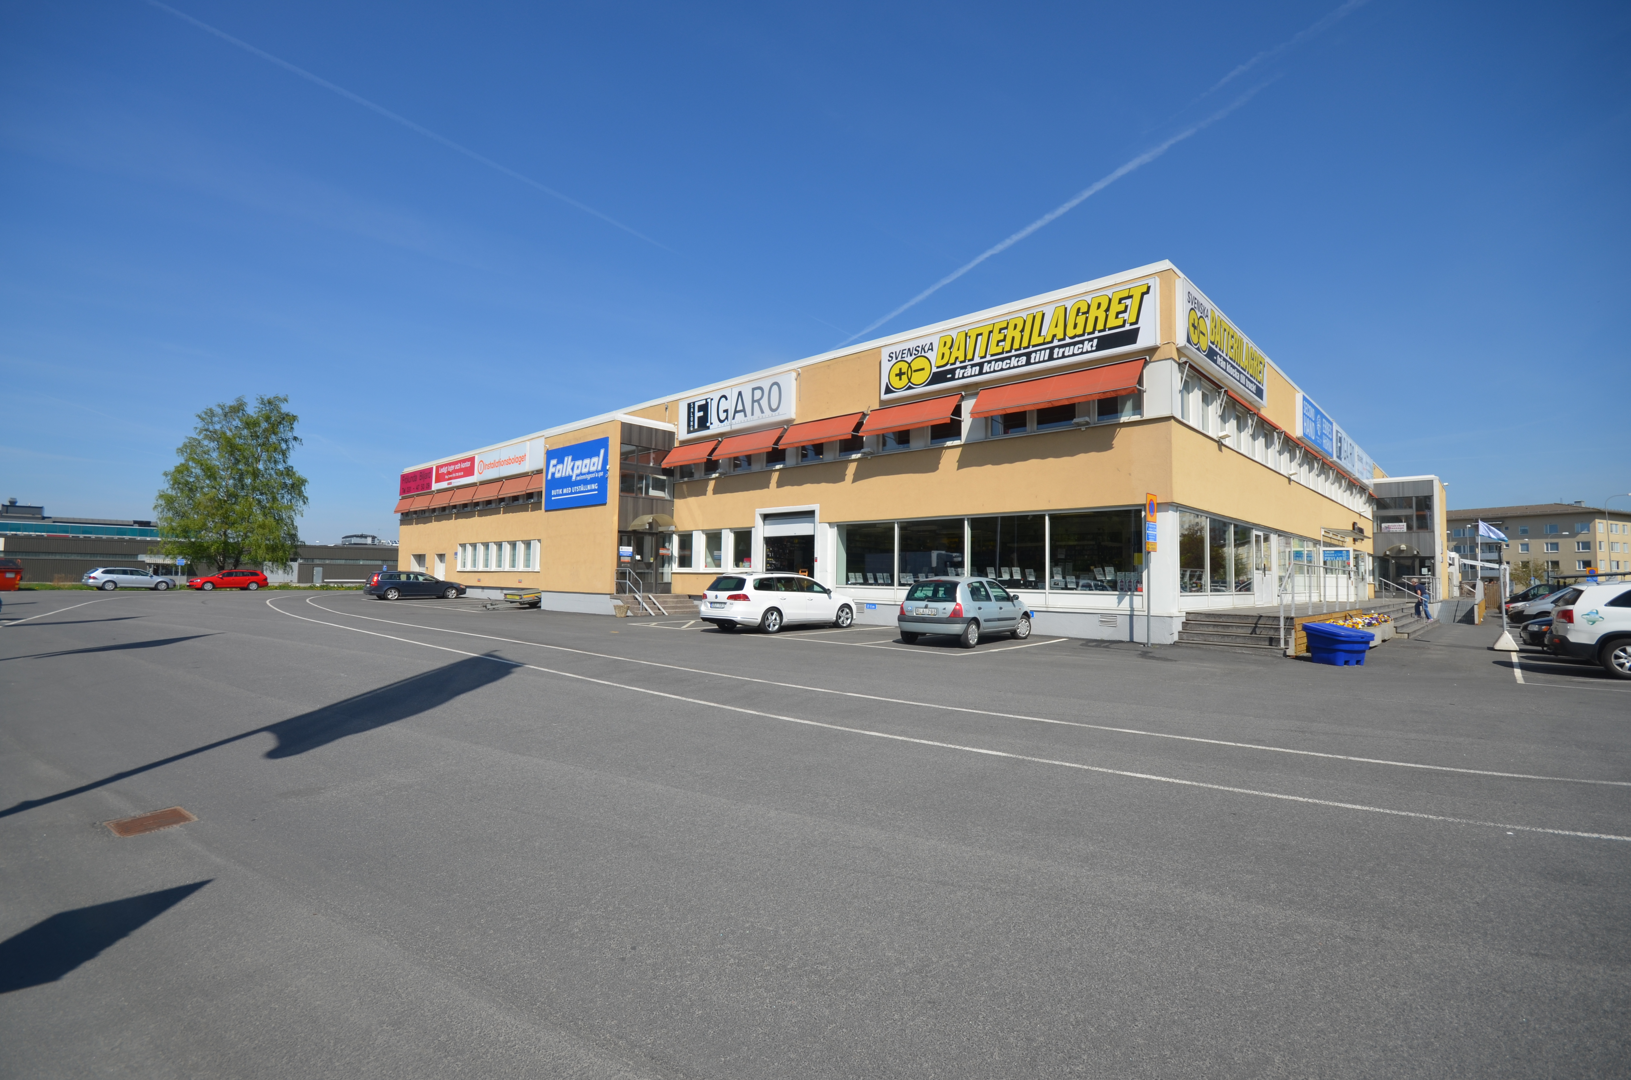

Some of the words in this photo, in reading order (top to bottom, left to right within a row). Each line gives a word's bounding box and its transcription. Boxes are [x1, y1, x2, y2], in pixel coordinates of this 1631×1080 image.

[1187, 291, 1209, 320] SVENSKA
[935, 283, 1151, 368] BATTERILAGRET
[887, 342, 934, 362] SVENSKA
[955, 365, 980, 379] från
[983, 350, 1026, 373] klocka
[1030, 347, 1049, 364] till
[1053, 339, 1097, 359] truck!
[1209, 308, 1265, 387] BATTERILAGRET
[695, 381, 782, 429] FIGARO
[547, 448, 605, 481] Folkpool
[552, 488, 562, 496] BUTIK
